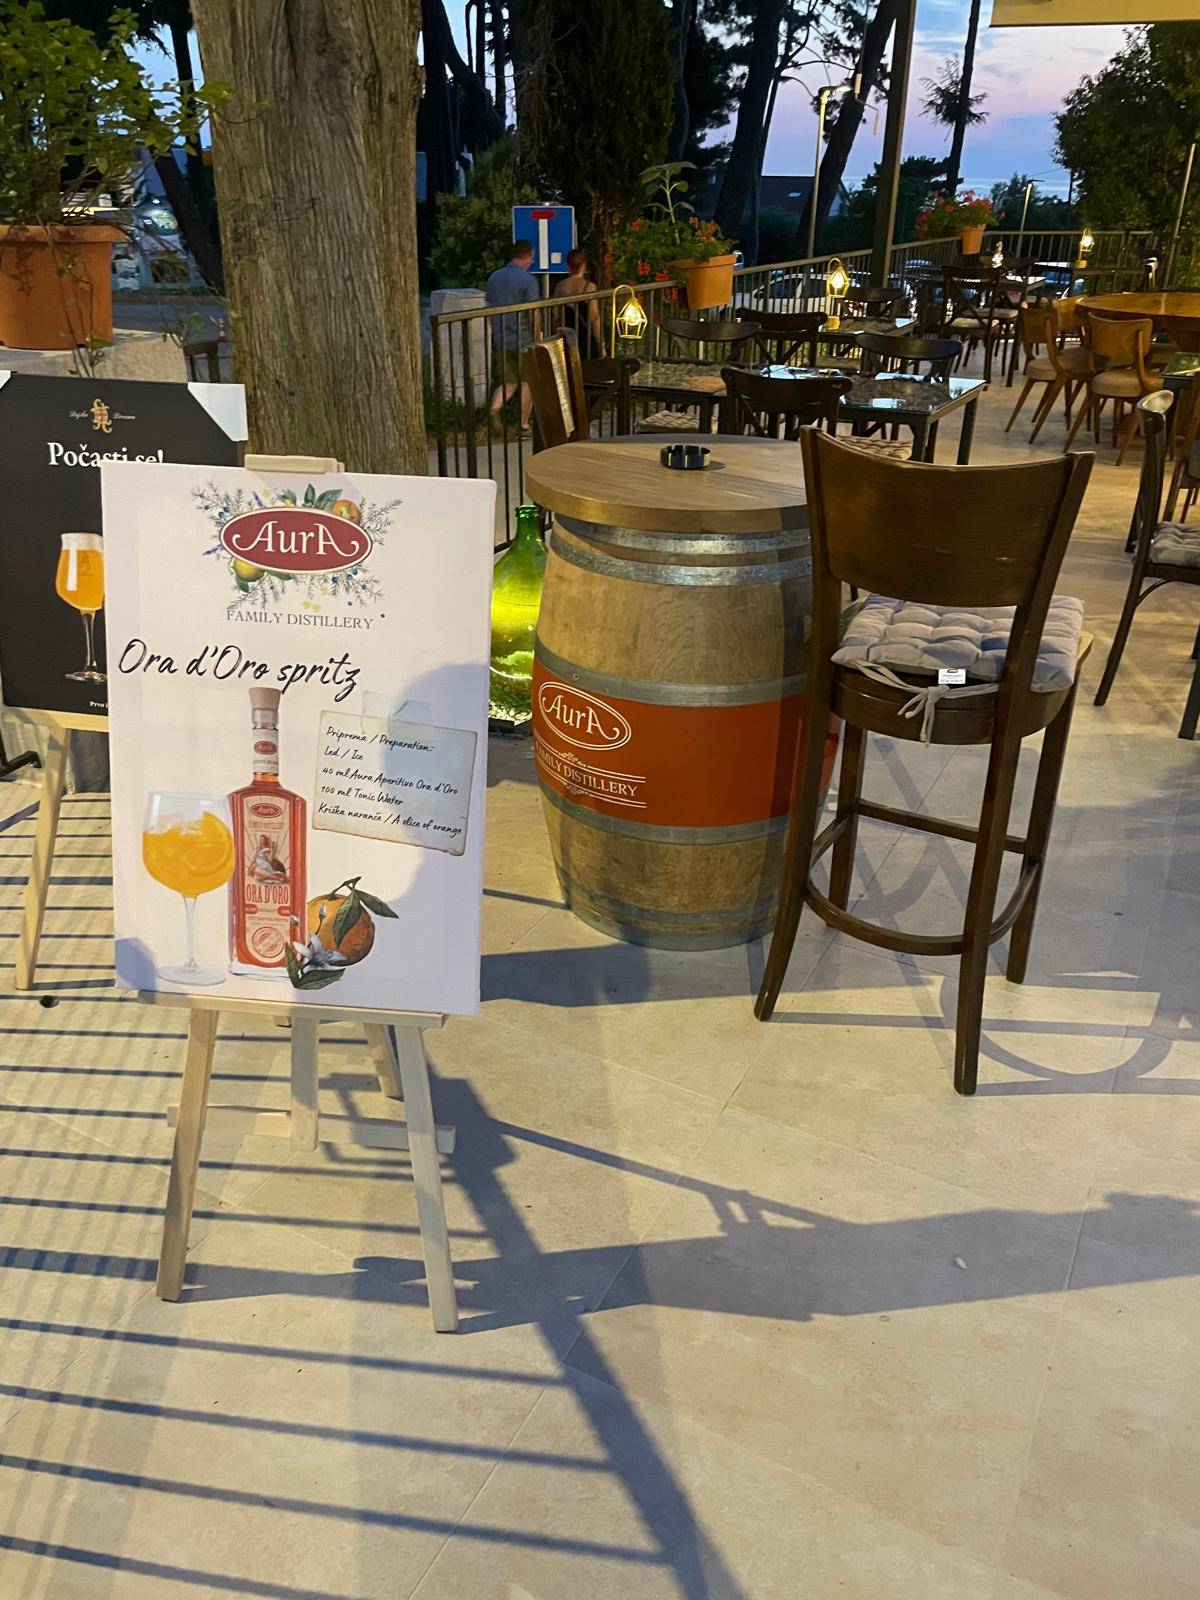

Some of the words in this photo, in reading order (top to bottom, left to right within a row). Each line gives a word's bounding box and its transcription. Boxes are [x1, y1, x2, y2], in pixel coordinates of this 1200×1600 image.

[226, 610, 284, 625] FAMILY
[287, 613, 374, 630] DISTILLERY
[118, 638, 178, 674] Ora
[186, 645, 270, 680] d'Oro
[276, 652, 361, 702] spritz
[326, 726, 367, 742] Priprema
[324, 745, 339, 757] Led
[351, 749, 365, 761] Ice
[535, 739, 562, 772] MILY
[563, 765, 638, 797] DISTILLERY
[322, 767, 334, 775] 40
[335, 768, 350, 778] ml
[348, 769, 374, 781] Aura
[373, 772, 414, 788] Aperitivo
[416, 779, 433, 791] Ora
[321, 786, 336, 794] 100
[337, 787, 353, 798] ml
[354, 788, 376, 801] Tonic
[377, 792, 403, 805] Water
[422, 819, 434, 831] of
[433, 825, 462, 838] orange
[246, 884, 263, 904] ORA
